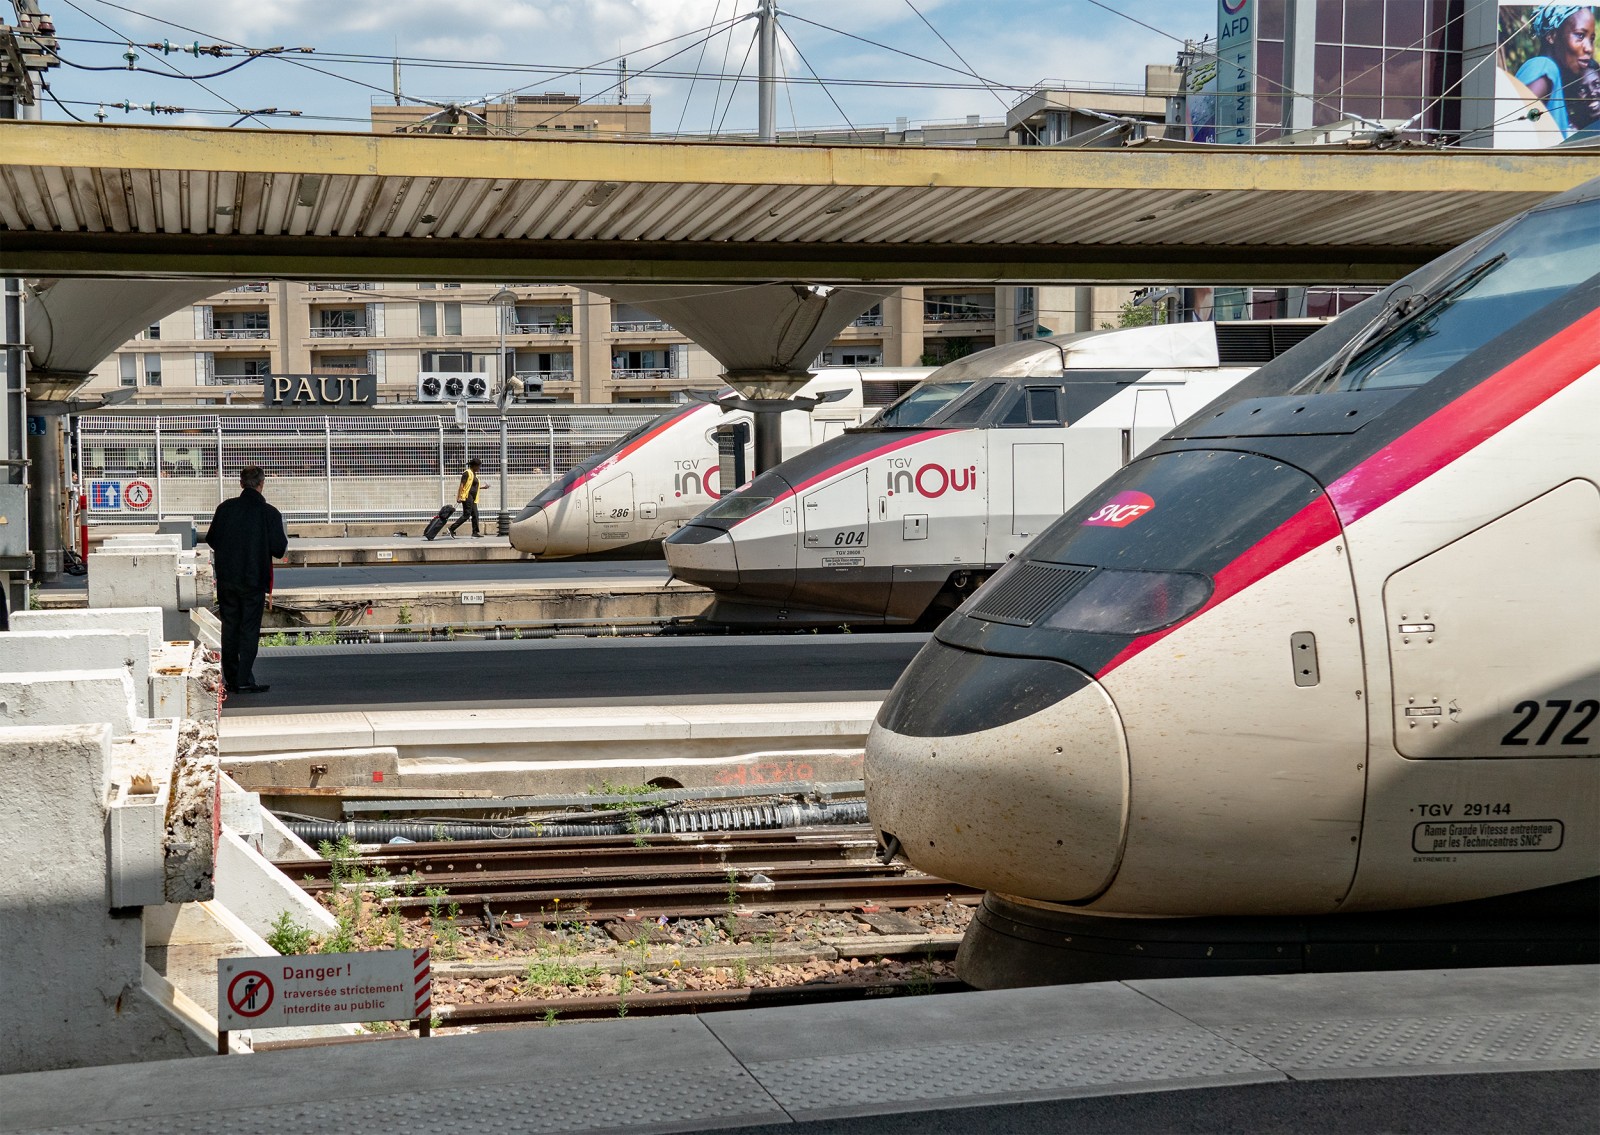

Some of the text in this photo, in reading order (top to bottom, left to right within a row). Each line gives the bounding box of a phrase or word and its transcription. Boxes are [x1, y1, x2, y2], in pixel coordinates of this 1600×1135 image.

[1222, 17, 1249, 39] AFD
[1236, 53, 1246, 145] PEMENT
[272, 377, 369, 402] PAUL
[674, 460, 699, 470] TGV
[887, 458, 912, 468] TGV
[610, 508, 629, 519] 286
[1088, 504, 1150, 522] SNCF
[834, 531, 865, 546] 604
[1500, 699, 1600, 746] 272
[1418, 803, 1511, 817] TGV 29144
[1424, 823, 1553, 836] Rame Grande Vitesse entretenue
[1433, 834, 1543, 850] par les Technicentres SNCF
[283, 966, 342, 981] Danger
[283, 983, 404, 999] traversée strictement
[283, 999, 385, 1014] interdite au public
